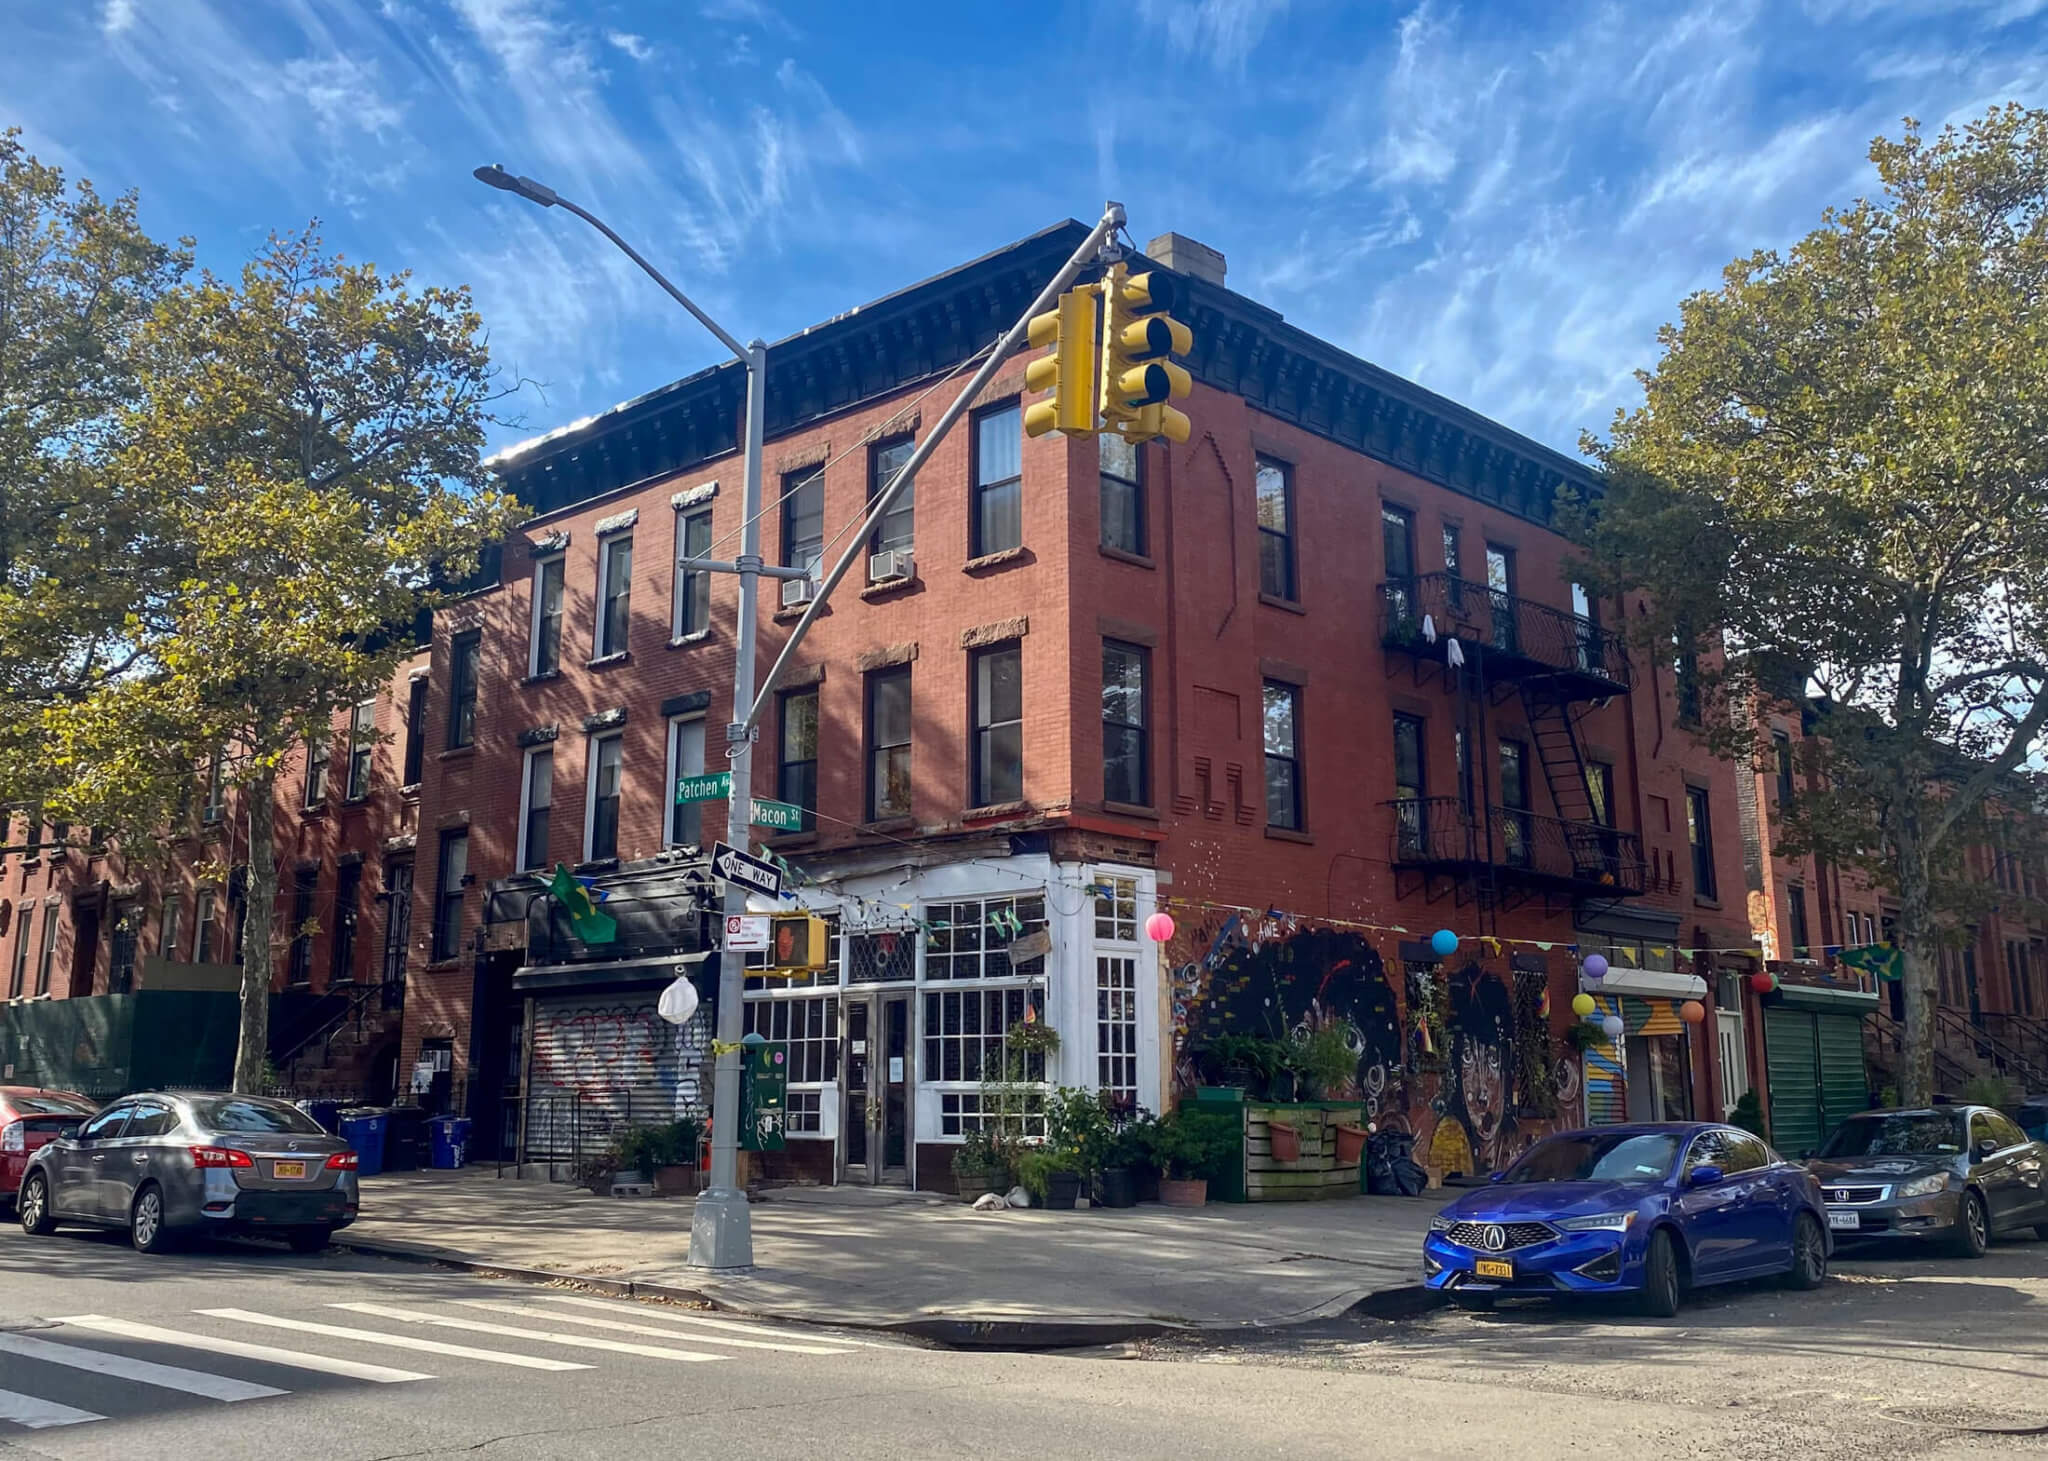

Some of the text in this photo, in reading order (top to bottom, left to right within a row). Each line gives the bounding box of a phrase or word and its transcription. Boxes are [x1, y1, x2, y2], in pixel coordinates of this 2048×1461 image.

[679, 780, 718, 800] Patchen
[753, 802, 799, 825] Macon St
[724, 857, 773, 887] ONE WAY
